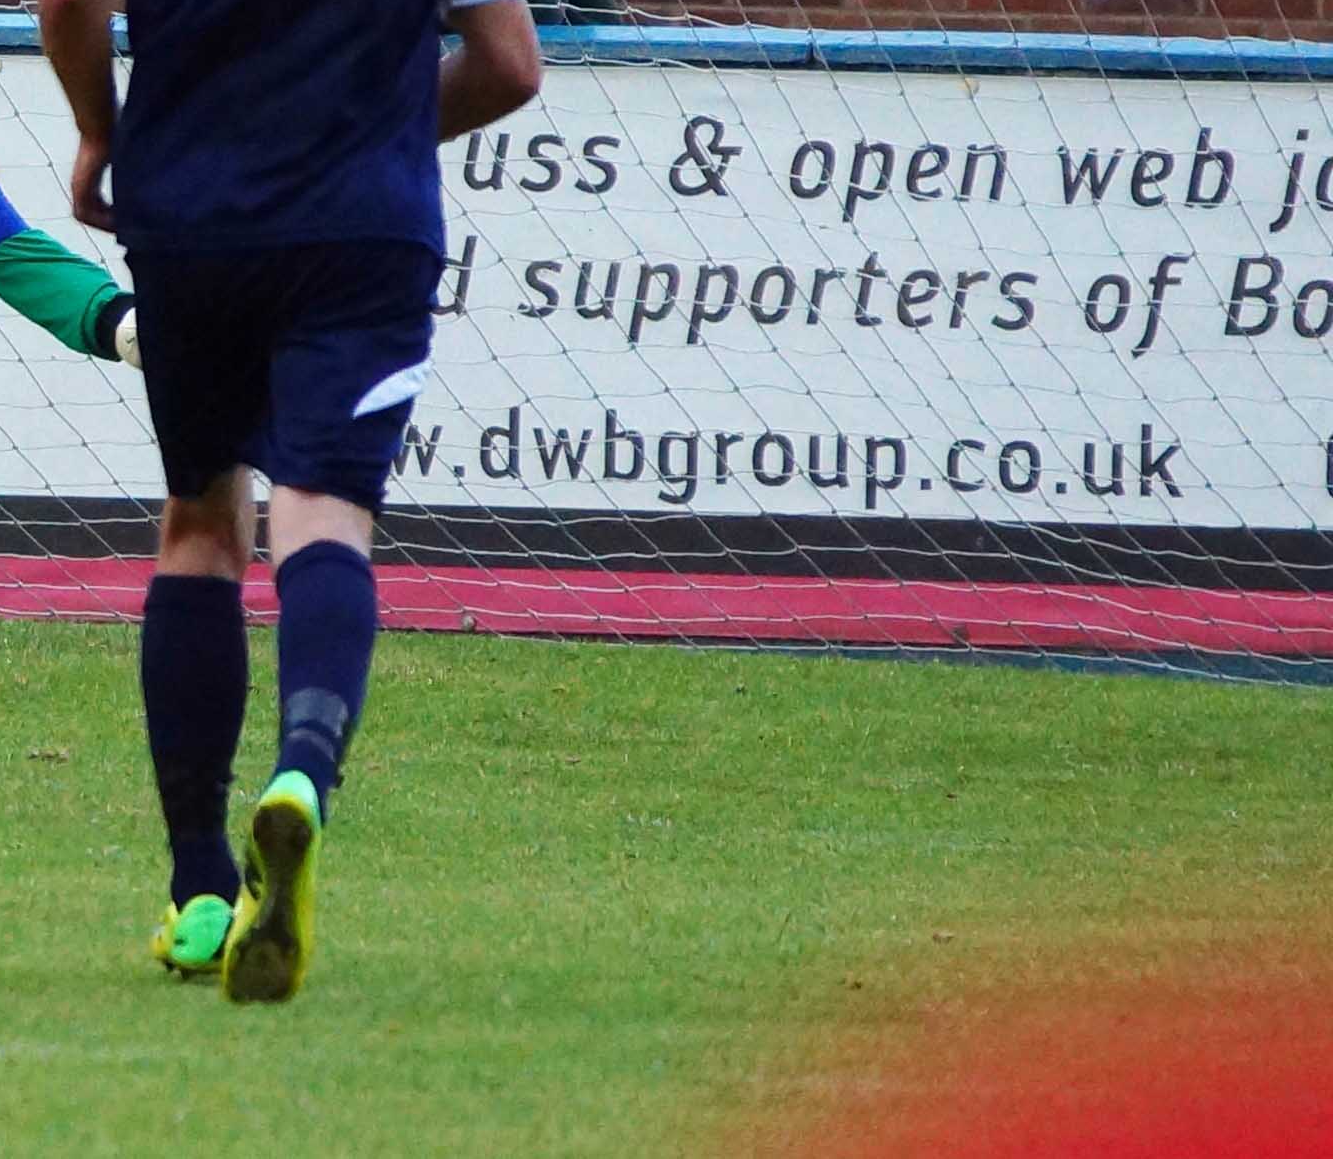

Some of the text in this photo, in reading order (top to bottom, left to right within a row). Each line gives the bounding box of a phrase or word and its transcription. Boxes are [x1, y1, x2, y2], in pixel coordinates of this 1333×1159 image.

[669, 115, 742, 197] &
[789, 138, 1009, 223] open
[1058, 127, 1236, 209] web
[517, 252, 1038, 344] supporters
[1083, 252, 1190, 359] of
